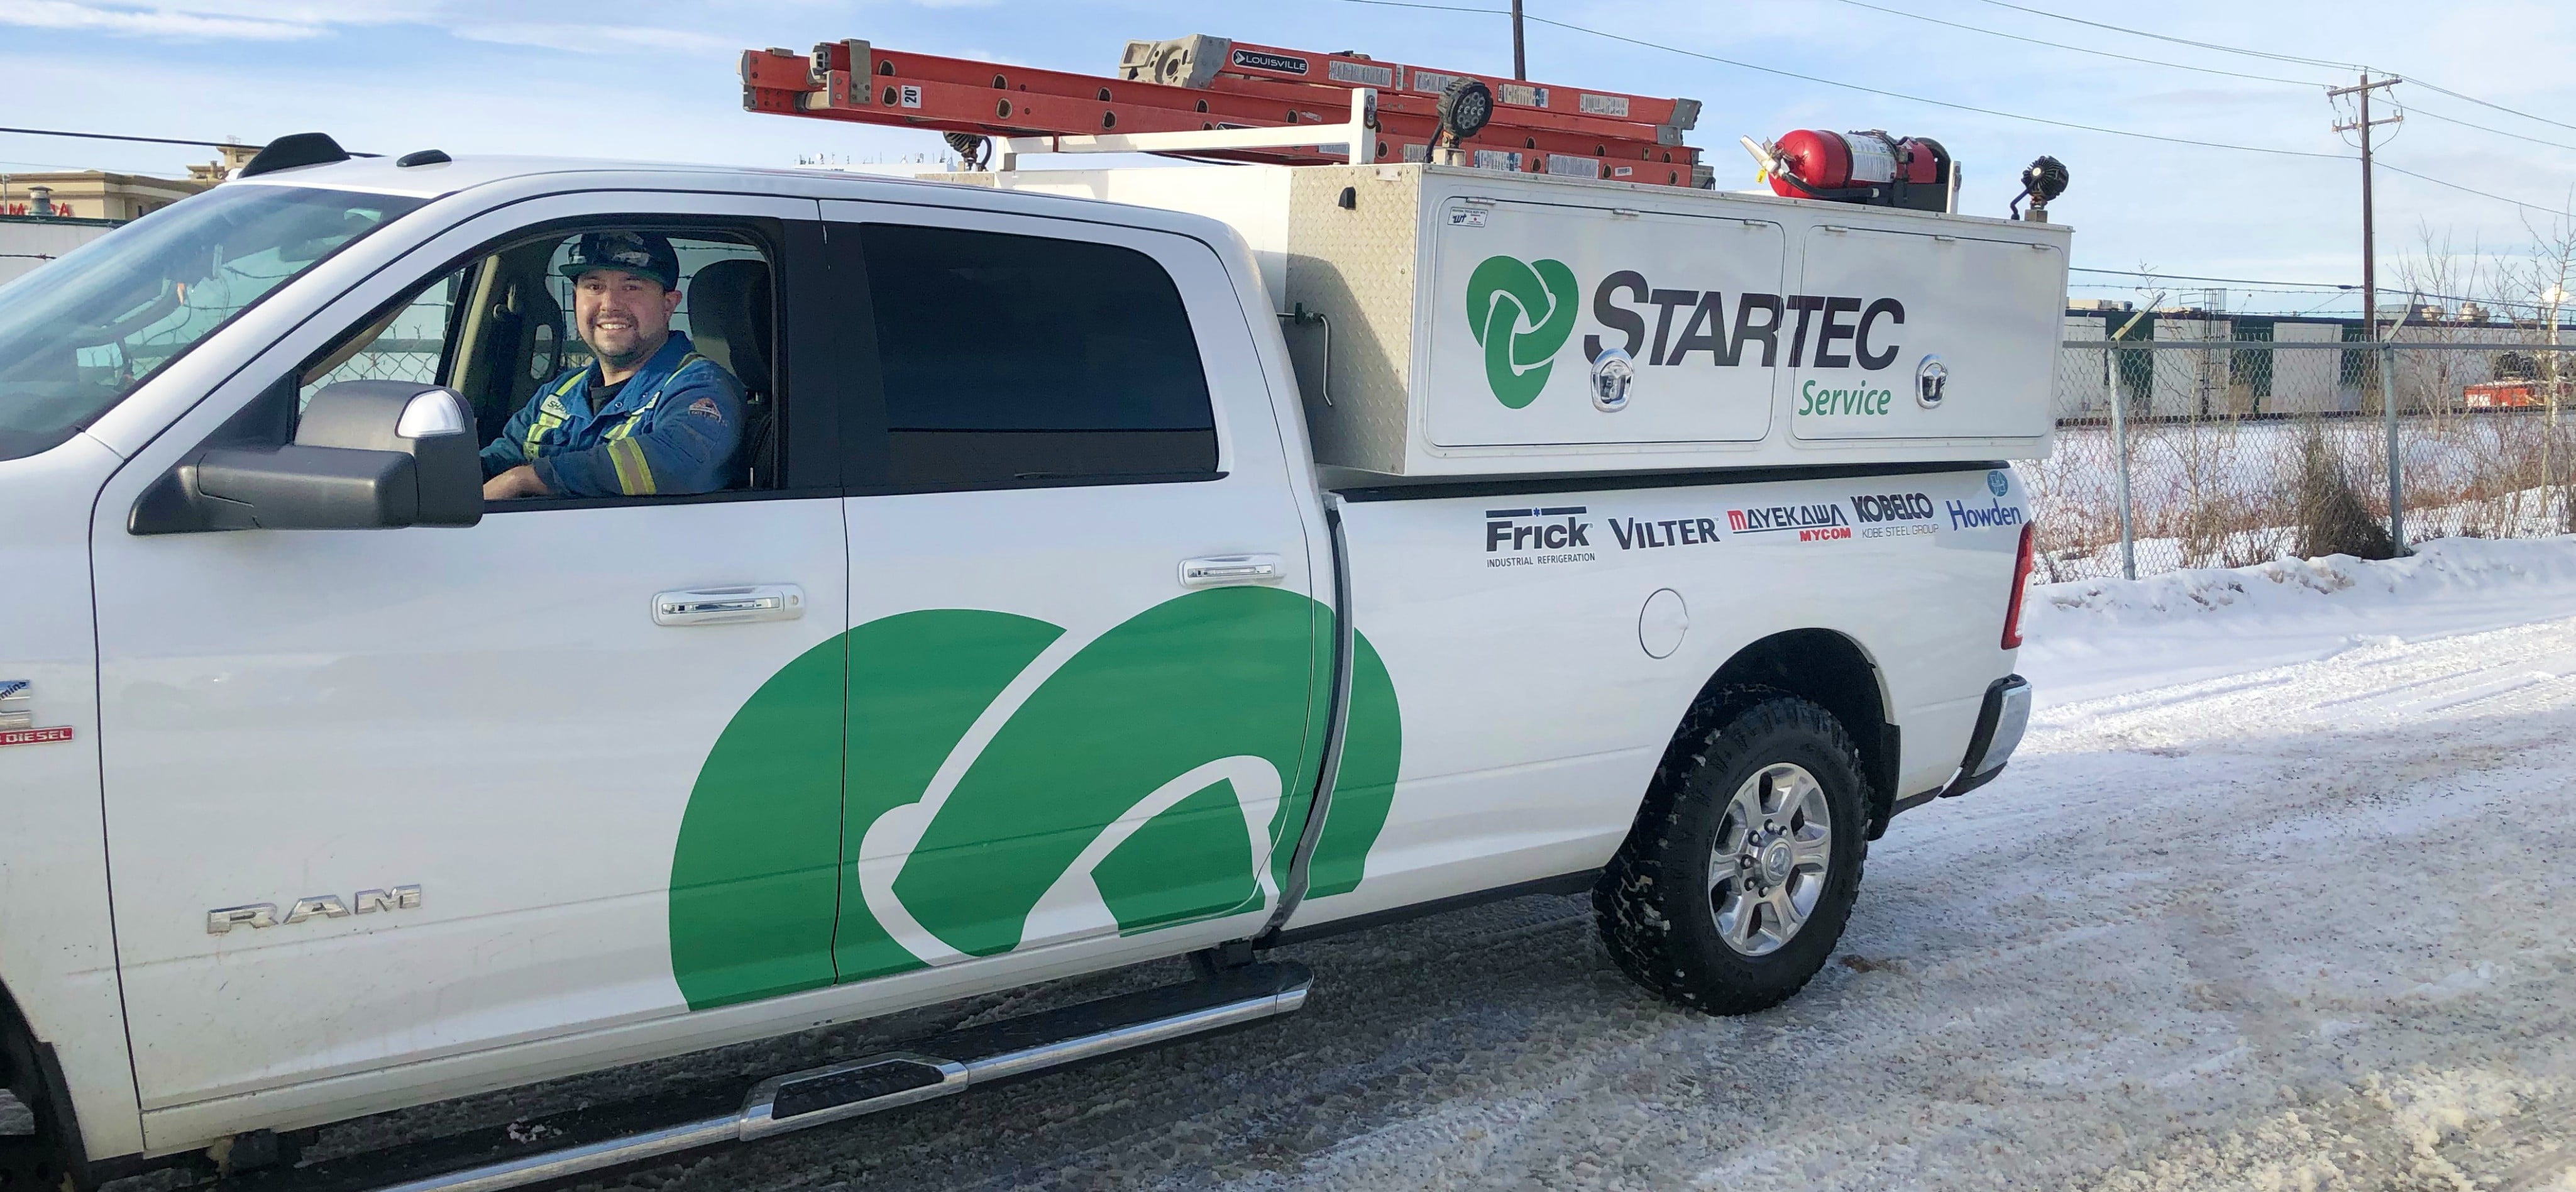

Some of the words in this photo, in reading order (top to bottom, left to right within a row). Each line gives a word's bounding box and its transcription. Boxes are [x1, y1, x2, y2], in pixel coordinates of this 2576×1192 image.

[1246, 55, 1306, 70] LOUISVILLE
[1583, 270, 1905, 370] STARTEC
[1798, 380, 1891, 416] Service
[1727, 504, 1849, 531] MAYEKAWA
[1850, 492, 1934, 523] KOBELCO
[1946, 497, 2022, 531] Howden
[1486, 517, 1590, 552] Frick
[1607, 517, 1720, 550] VILTER
[1799, 528, 1851, 542] MYCOM
[1862, 527, 1883, 538] KOBE
[1885, 524, 1910, 536] STEEL
[1912, 524, 1939, 535] GROUP
[1487, 557, 1534, 568] INDUSTRIAL
[1537, 553, 1595, 565] REFRIGERATION
[0, 682, 26, 700] mins
[6, 730, 70, 743] DIESEL
[207, 884, 422, 934] RAM
